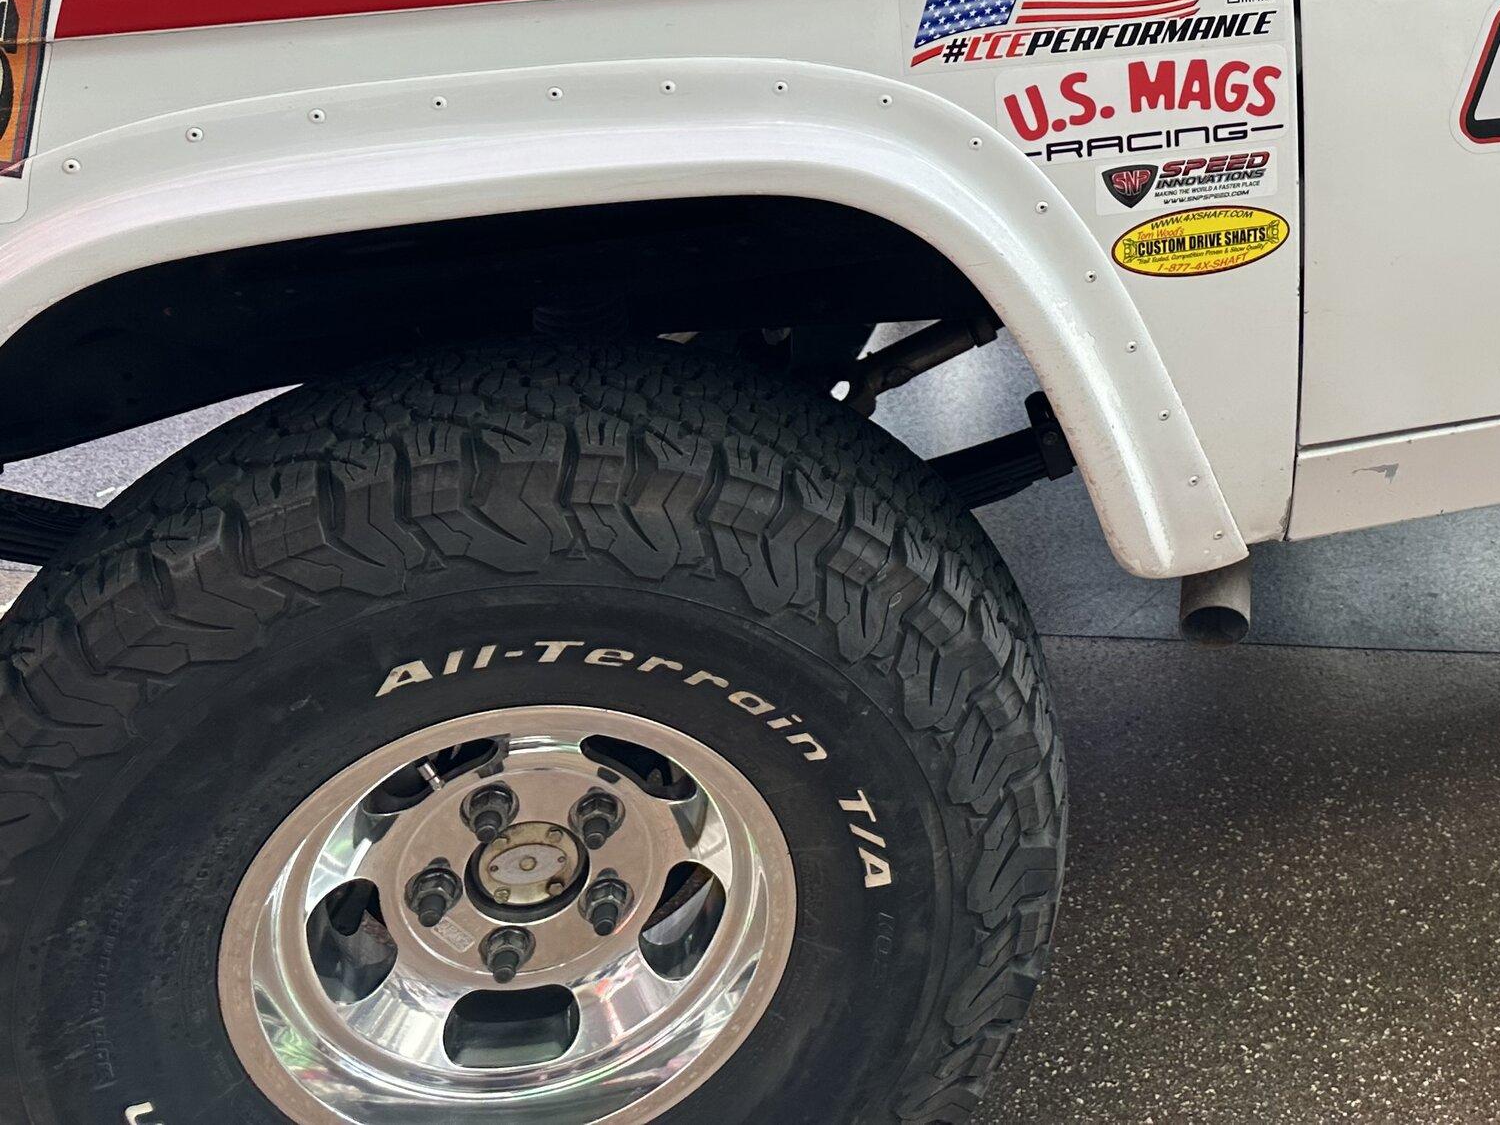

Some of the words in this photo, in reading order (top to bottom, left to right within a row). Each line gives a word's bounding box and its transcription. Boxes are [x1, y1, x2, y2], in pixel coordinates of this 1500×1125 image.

[1003, 72, 1115, 142] U.S.
[1128, 59, 1282, 117] MAGS
[1045, 121, 1249, 162] RACING
[1155, 168, 1267, 190] INNOVATIONS
[1159, 151, 1271, 179] SPEED
[1111, 169, 1151, 196] SNP
[1154, 188, 1178, 198] MAKING
[1179, 187, 1190, 195] THE
[1191, 185, 1213, 194] WORLD
[1219, 182, 1241, 191] FASTER
[1242, 180, 1261, 188] PLACE
[1150, 209, 1254, 231] WWW.4XSHAFT.COM
[1137, 236, 1186, 258] CUSTOM
[1189, 232, 1222, 251] DRIVE
[1224, 227, 1266, 247] SHAFTS
[374, 640, 831, 763] All-Terrain
[837, 789, 893, 889] T/A
